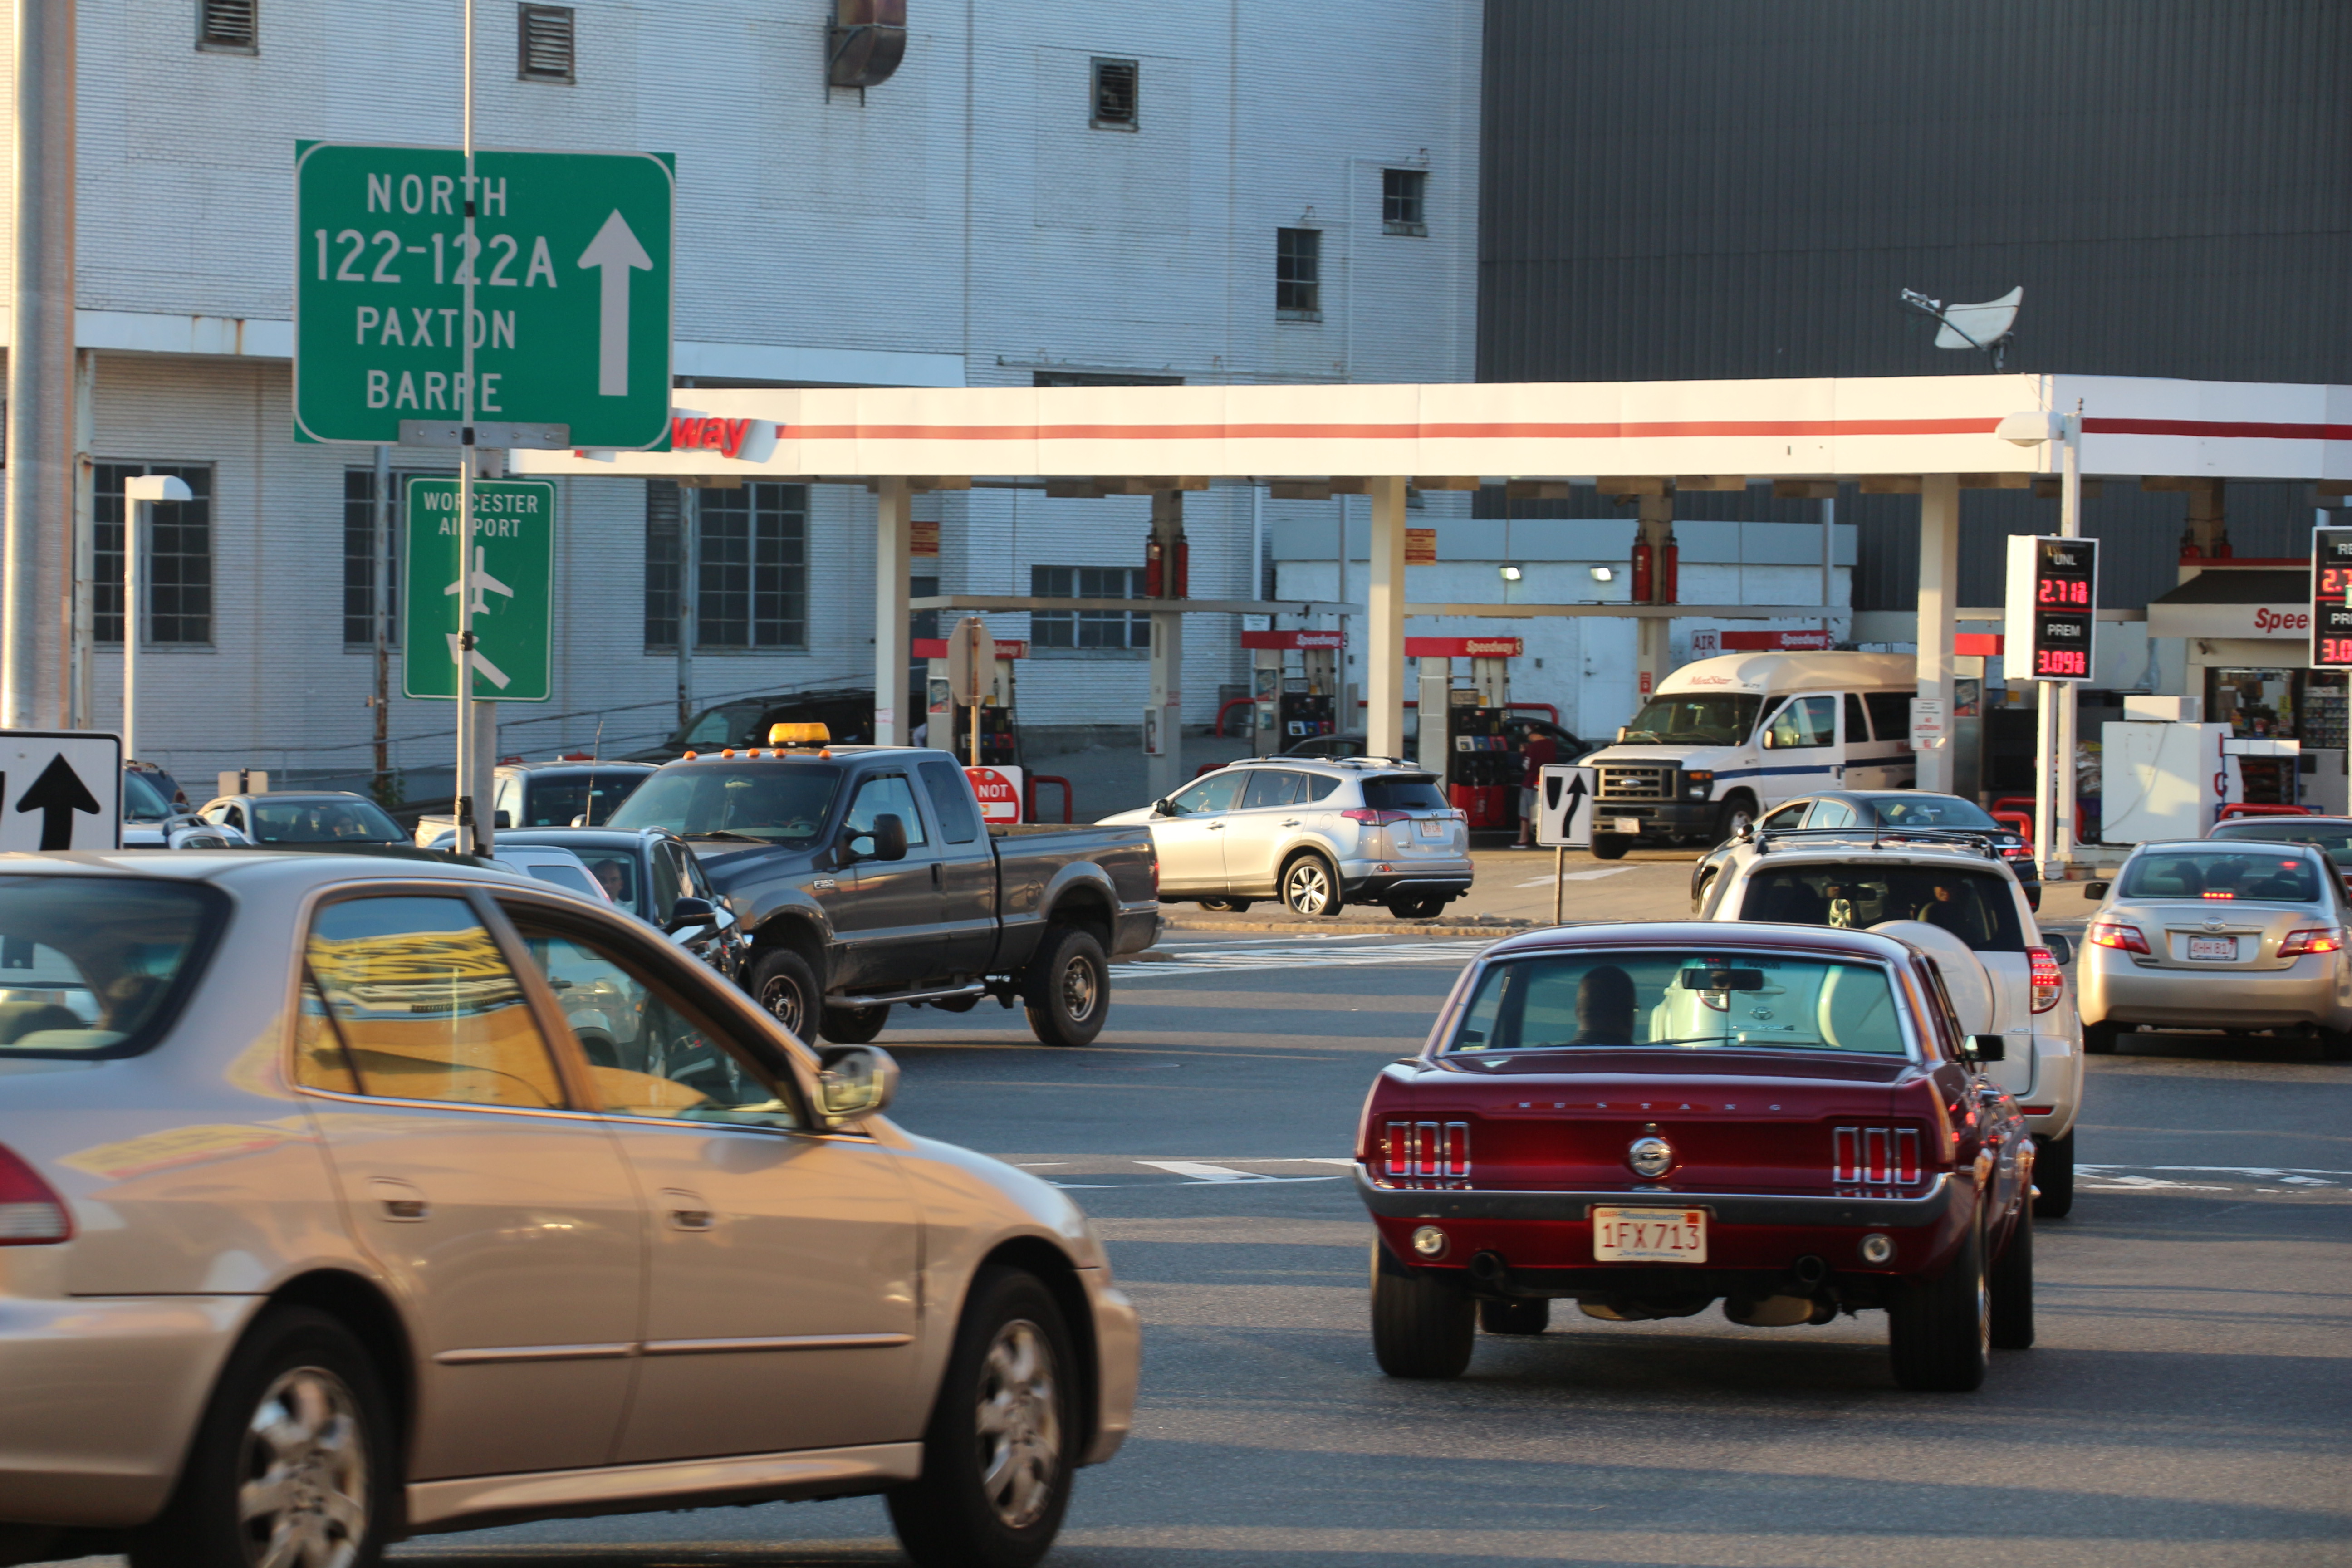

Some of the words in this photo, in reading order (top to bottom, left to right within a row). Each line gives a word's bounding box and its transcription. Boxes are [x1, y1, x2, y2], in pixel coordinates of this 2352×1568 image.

[368, 173, 506, 216] NORH
[315, 229, 557, 288] 122-122A
[357, 306, 515, 349] PAXTON
[438, 517, 521, 538] AIPORT
[2053, 553, 2077, 565] UNL
[2047, 623, 2081, 637] PREM
[1465, 639, 1514, 655] Speedway
[1693, 635, 1716, 650] AIR
[978, 784, 1009, 798] NOT
[1518, 1102, 1781, 1111] MUSTANG
